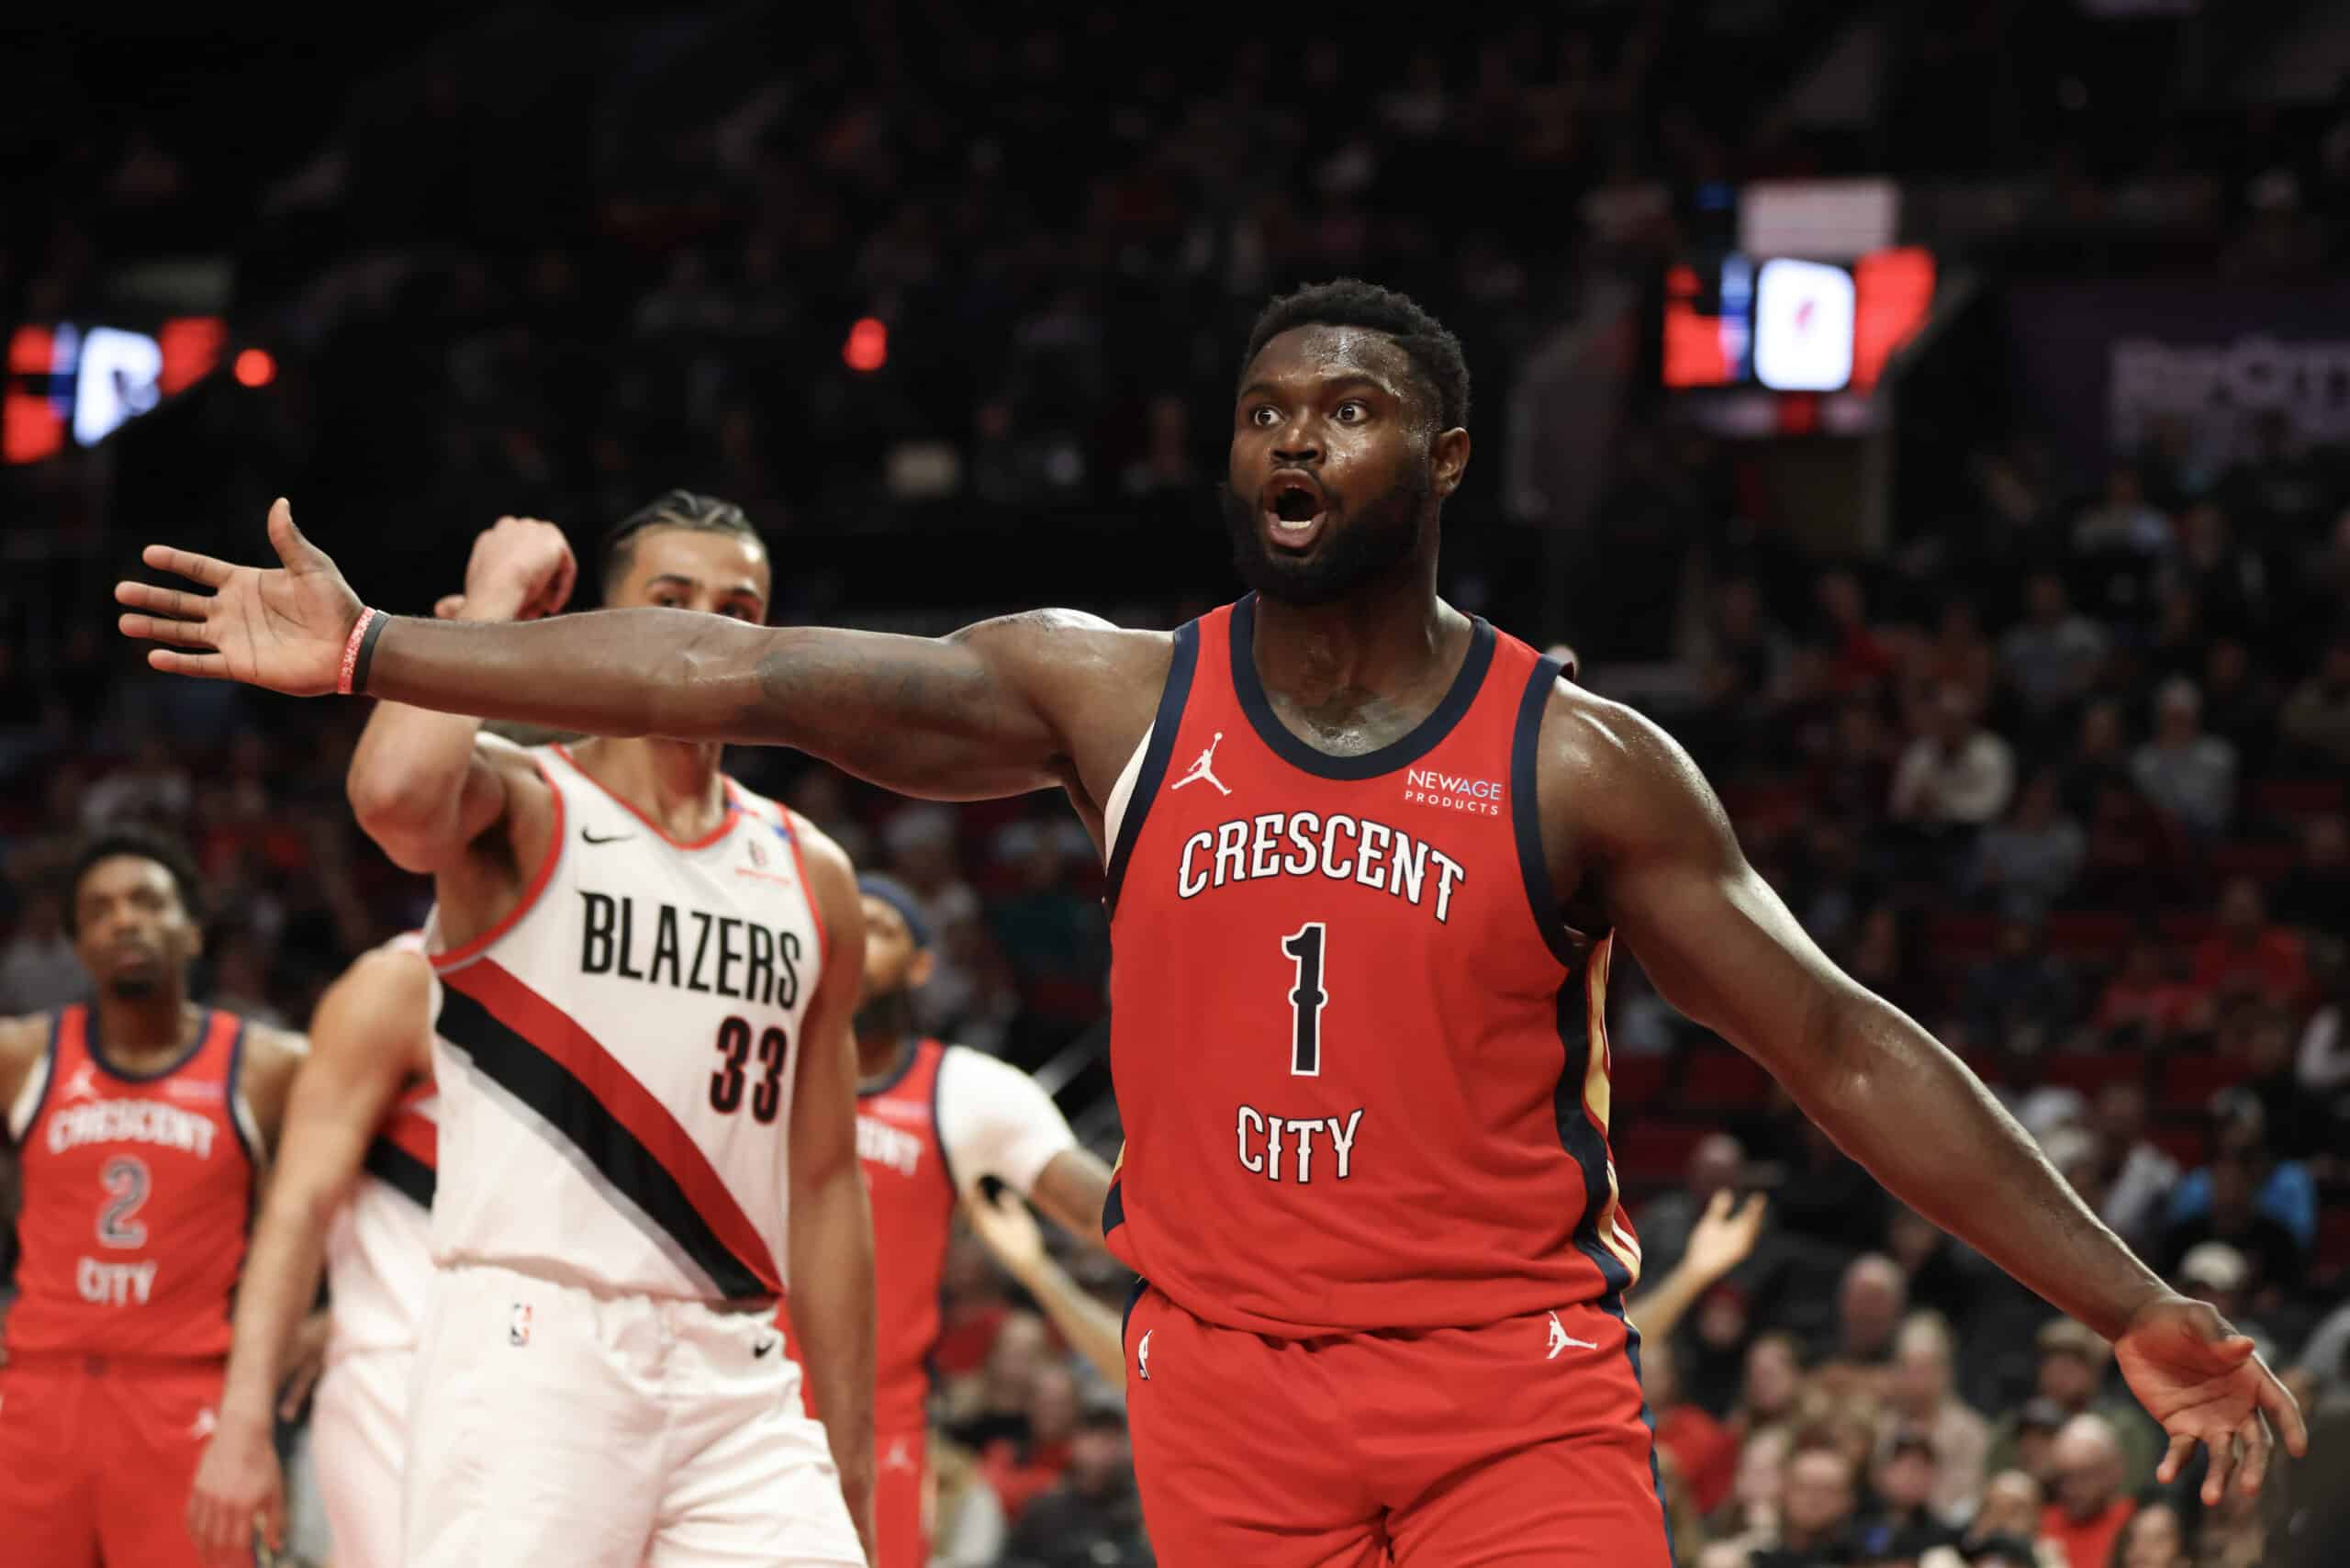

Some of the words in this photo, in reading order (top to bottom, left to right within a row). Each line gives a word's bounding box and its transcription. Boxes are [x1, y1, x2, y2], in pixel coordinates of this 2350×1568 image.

[1404, 790, 1499, 815] PRODUCTS
[1407, 768, 1502, 801] NEWAGE
[1178, 812, 1465, 924] CRESCENT
[577, 890, 801, 1011] BLAZERS
[1281, 922, 1327, 1076] 1
[710, 1015, 789, 1125] 33
[49, 1099, 216, 1159] CRESCENT
[1237, 1104, 1364, 1182] CITY
[97, 1154, 151, 1249] 2
[77, 1257, 157, 1307] CITY
